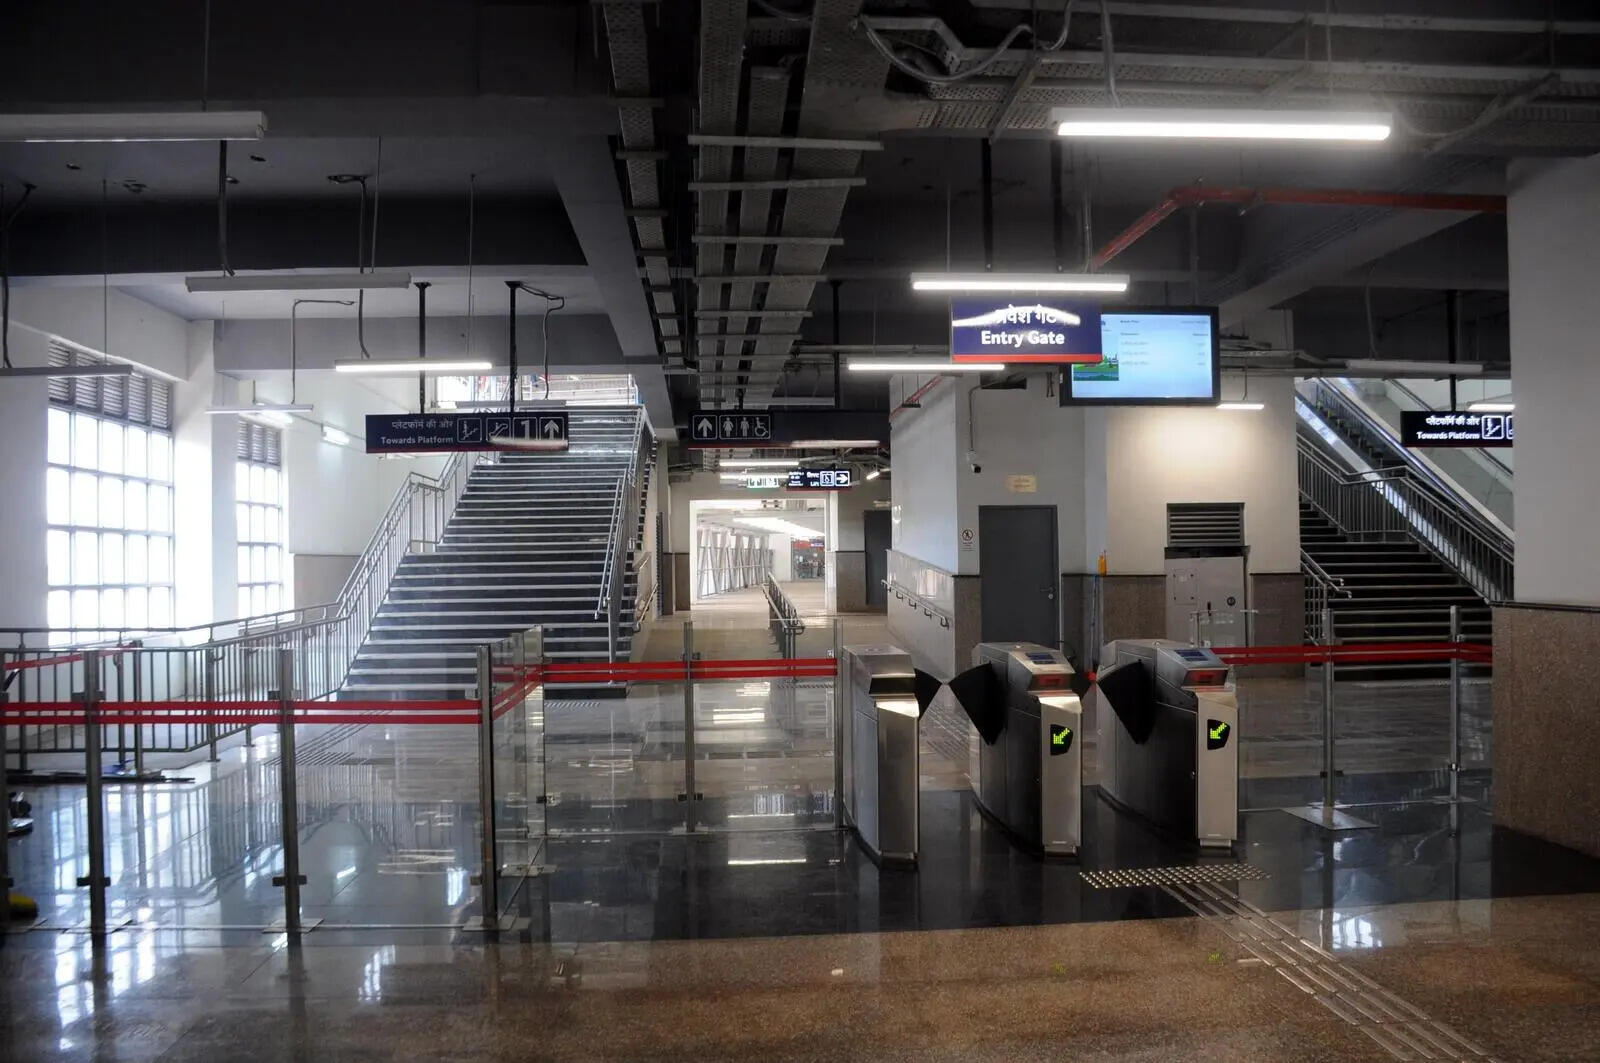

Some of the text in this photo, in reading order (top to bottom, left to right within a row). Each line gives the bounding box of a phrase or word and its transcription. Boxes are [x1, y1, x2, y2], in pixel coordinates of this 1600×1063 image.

[981, 331, 1065, 348] Entry Gate
[426, 419, 437, 429] की
[438, 418, 454, 429] ओर
[520, 420, 530, 441] 1
[1416, 431, 1480, 440] Towards Platform
[381, 435, 454, 444] Towards Platform
